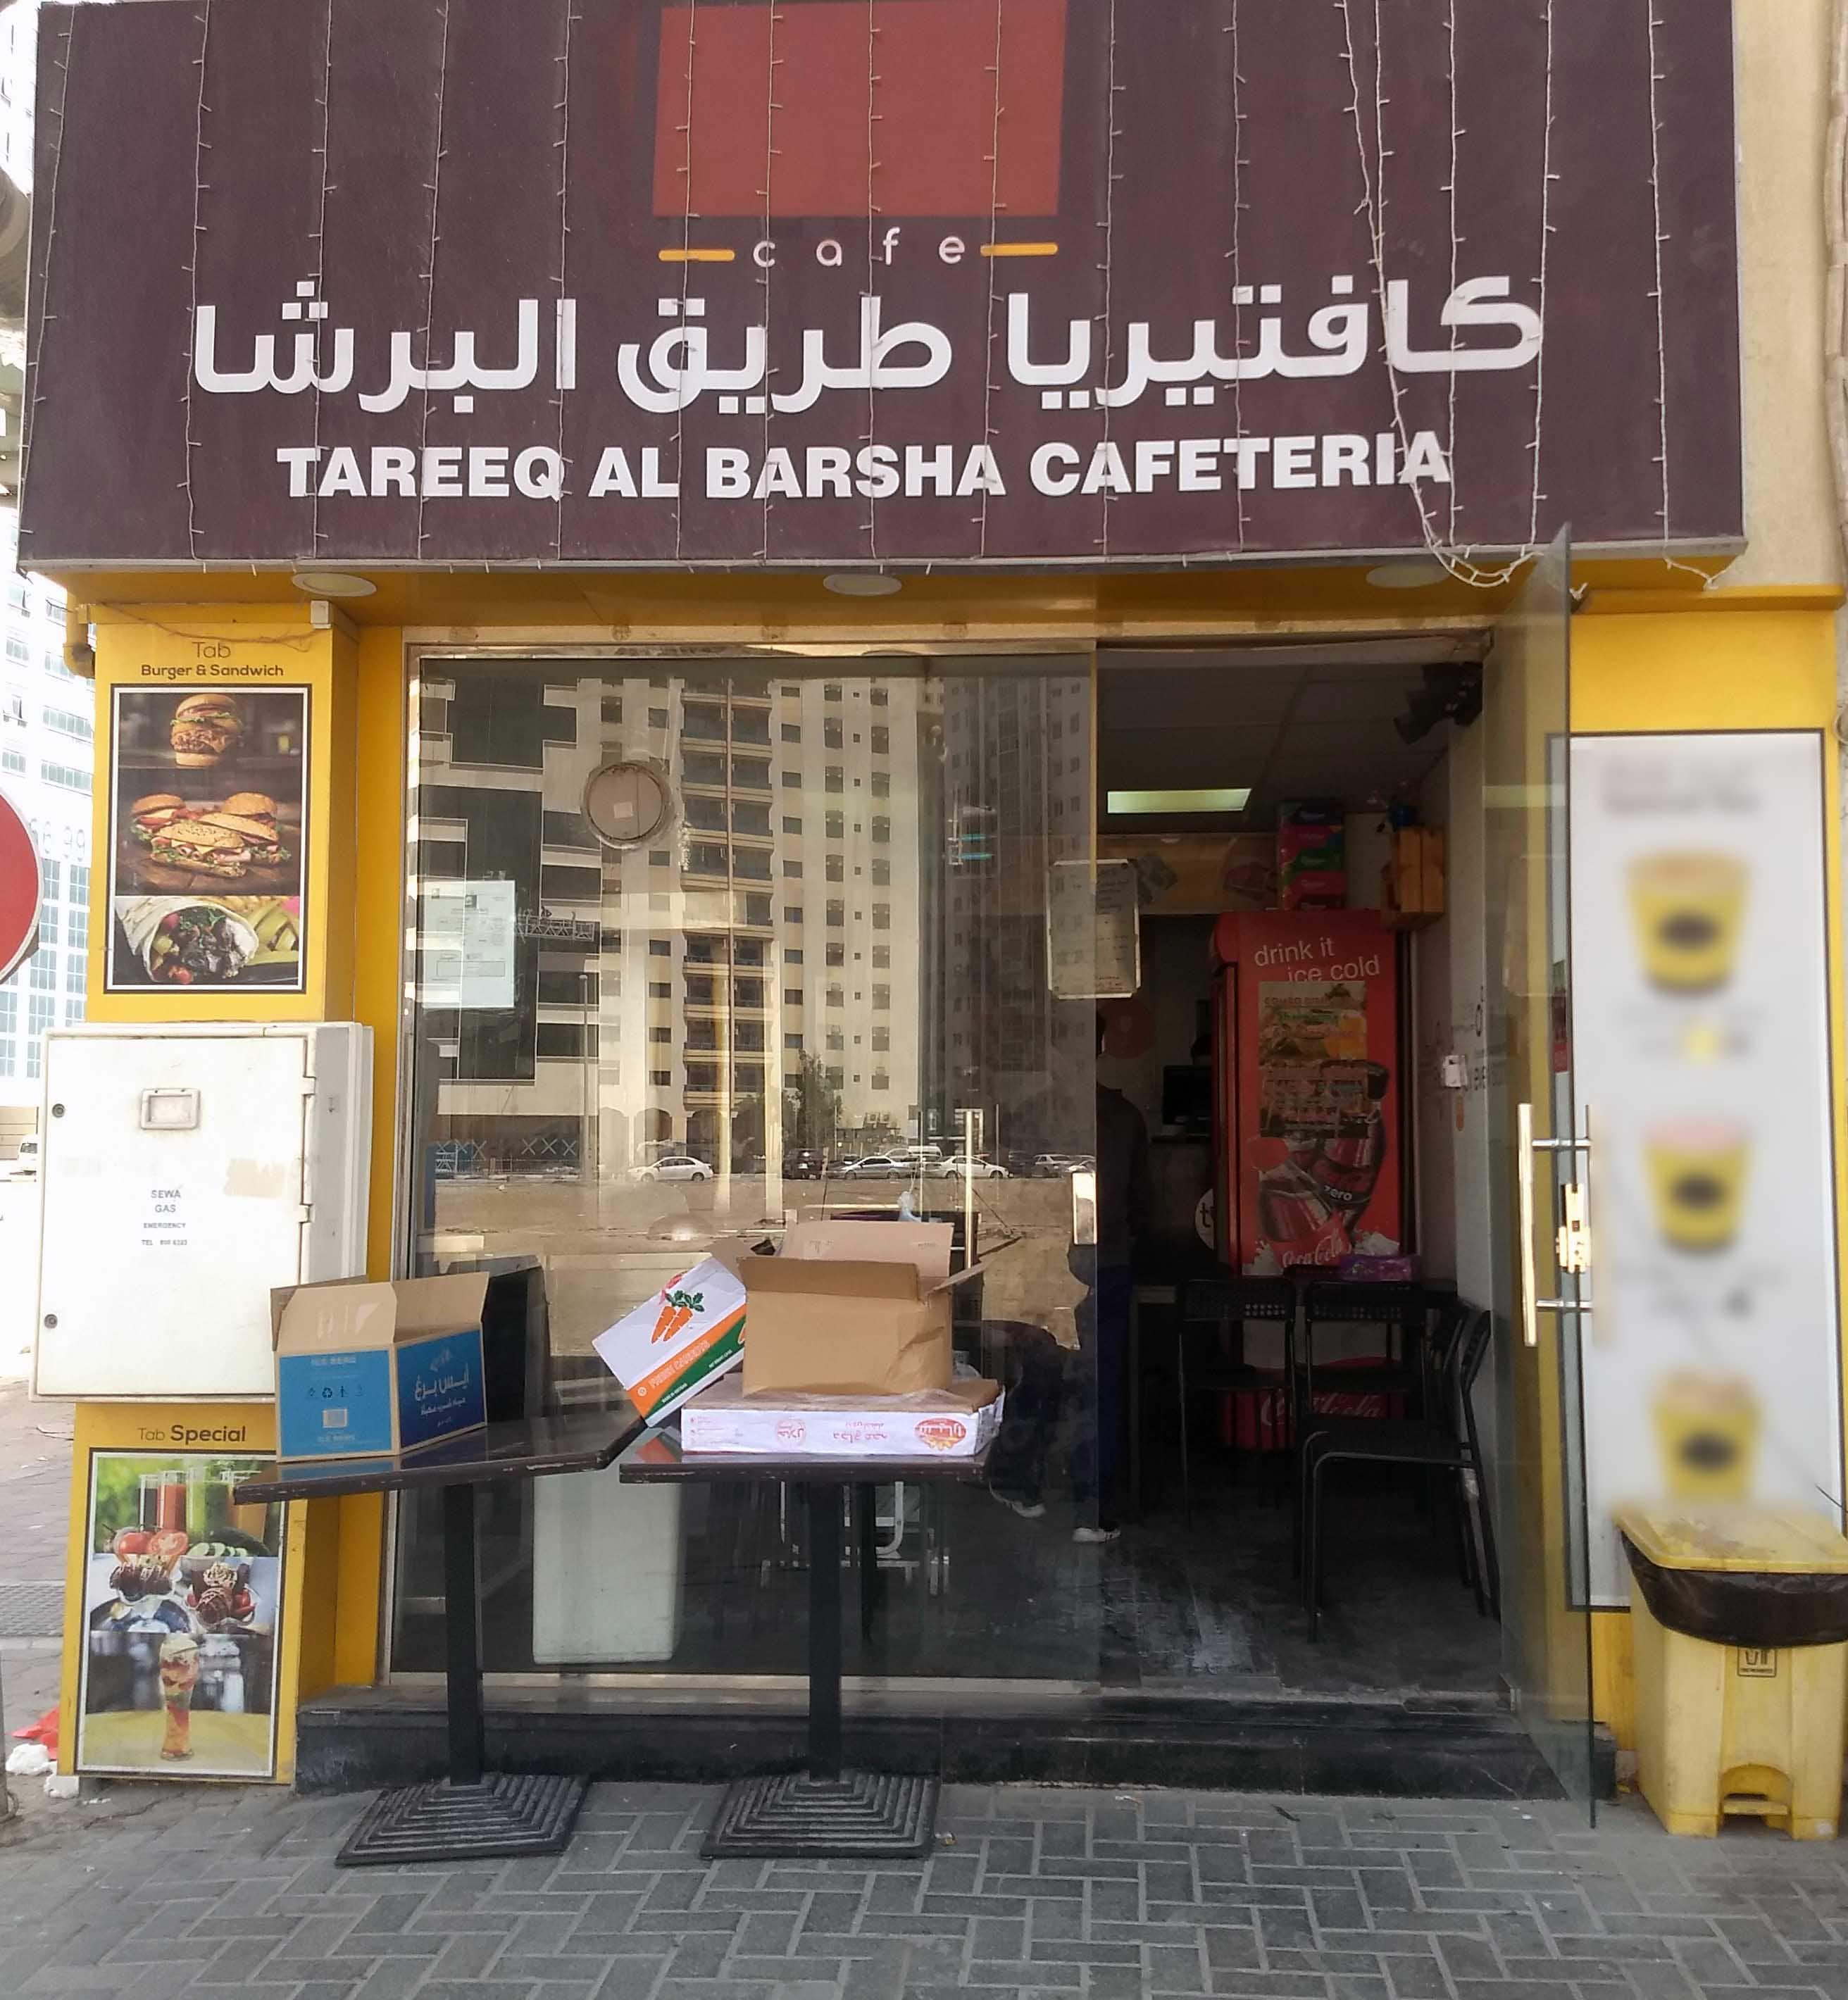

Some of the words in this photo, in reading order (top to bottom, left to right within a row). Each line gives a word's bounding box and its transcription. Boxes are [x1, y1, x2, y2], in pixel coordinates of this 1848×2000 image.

[753, 227, 965, 267] cafe
[194, 282, 577, 414] البرشا
[617, 296, 951, 414] طريق
[1008, 275, 1542, 409] كافتيريا
[276, 446, 563, 501] TAREEQ
[589, 447, 679, 498] AL
[706, 444, 1006, 499] BARSHA
[1029, 430, 1450, 496] CAFETERIA
[192, 642, 231, 658] Tab
[141, 664, 192, 680] Burger
[196, 665, 206, 676] &
[210, 664, 285, 676] Sandwich
[1254, 941, 1313, 966] drink
[1320, 937, 1335, 957] it
[1287, 966, 1323, 982] ice
[1330, 955, 1380, 980] cold
[151, 1189, 182, 1199] SEWA
[155, 1204, 176, 1213] GAS
[137, 1427, 166, 1441] Tab
[170, 1425, 246, 1445] Special
